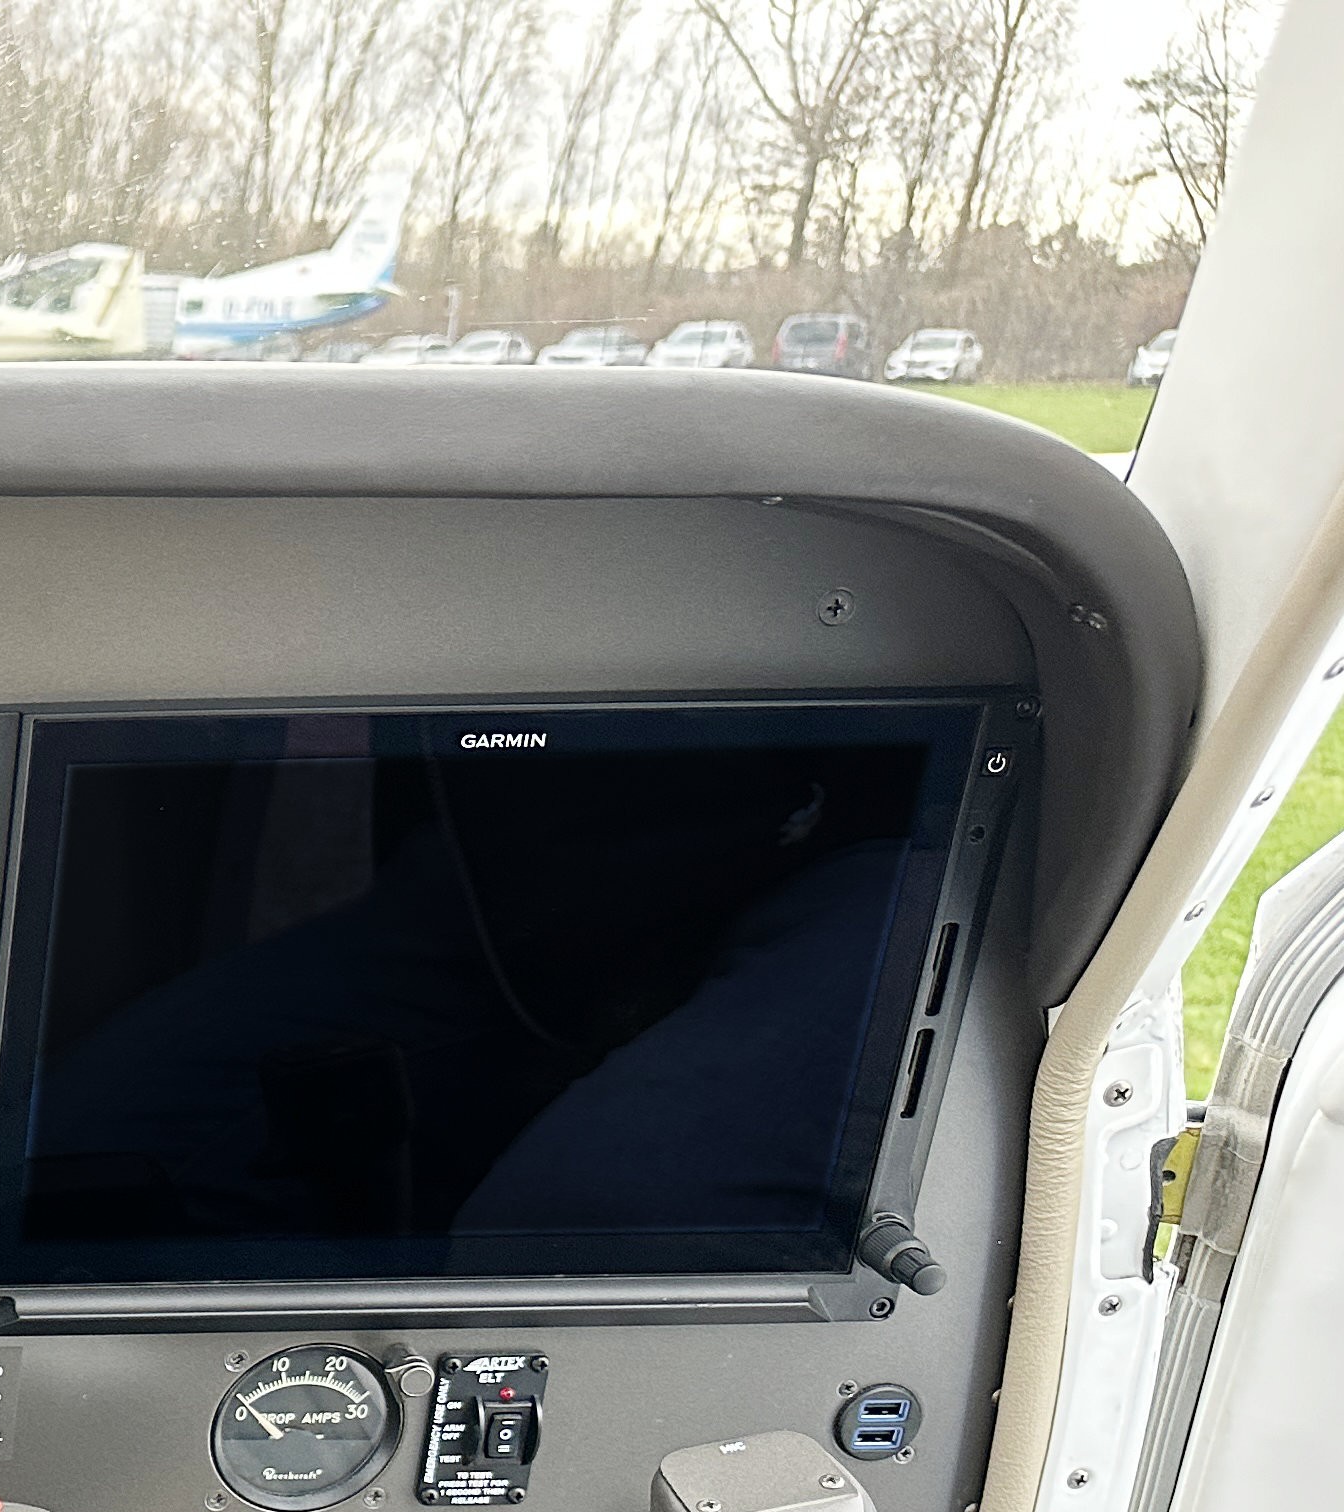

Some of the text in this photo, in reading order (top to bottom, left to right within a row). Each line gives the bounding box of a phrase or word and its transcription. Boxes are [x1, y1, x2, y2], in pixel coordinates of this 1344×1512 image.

[461, 734, 546, 749] GARMIN
[272, 1358, 290, 1373] 10
[324, 1356, 347, 1372] 20
[482, 1357, 526, 1369] ARTEX
[479, 1373, 505, 1384] ELT
[259, 1411, 340, 1426] PROP AMPS
[345, 1404, 368, 1420] 30
[424, 1378, 450, 1484] EMERGENCY USE ONLY
[439, 1455, 461, 1463] TEST
